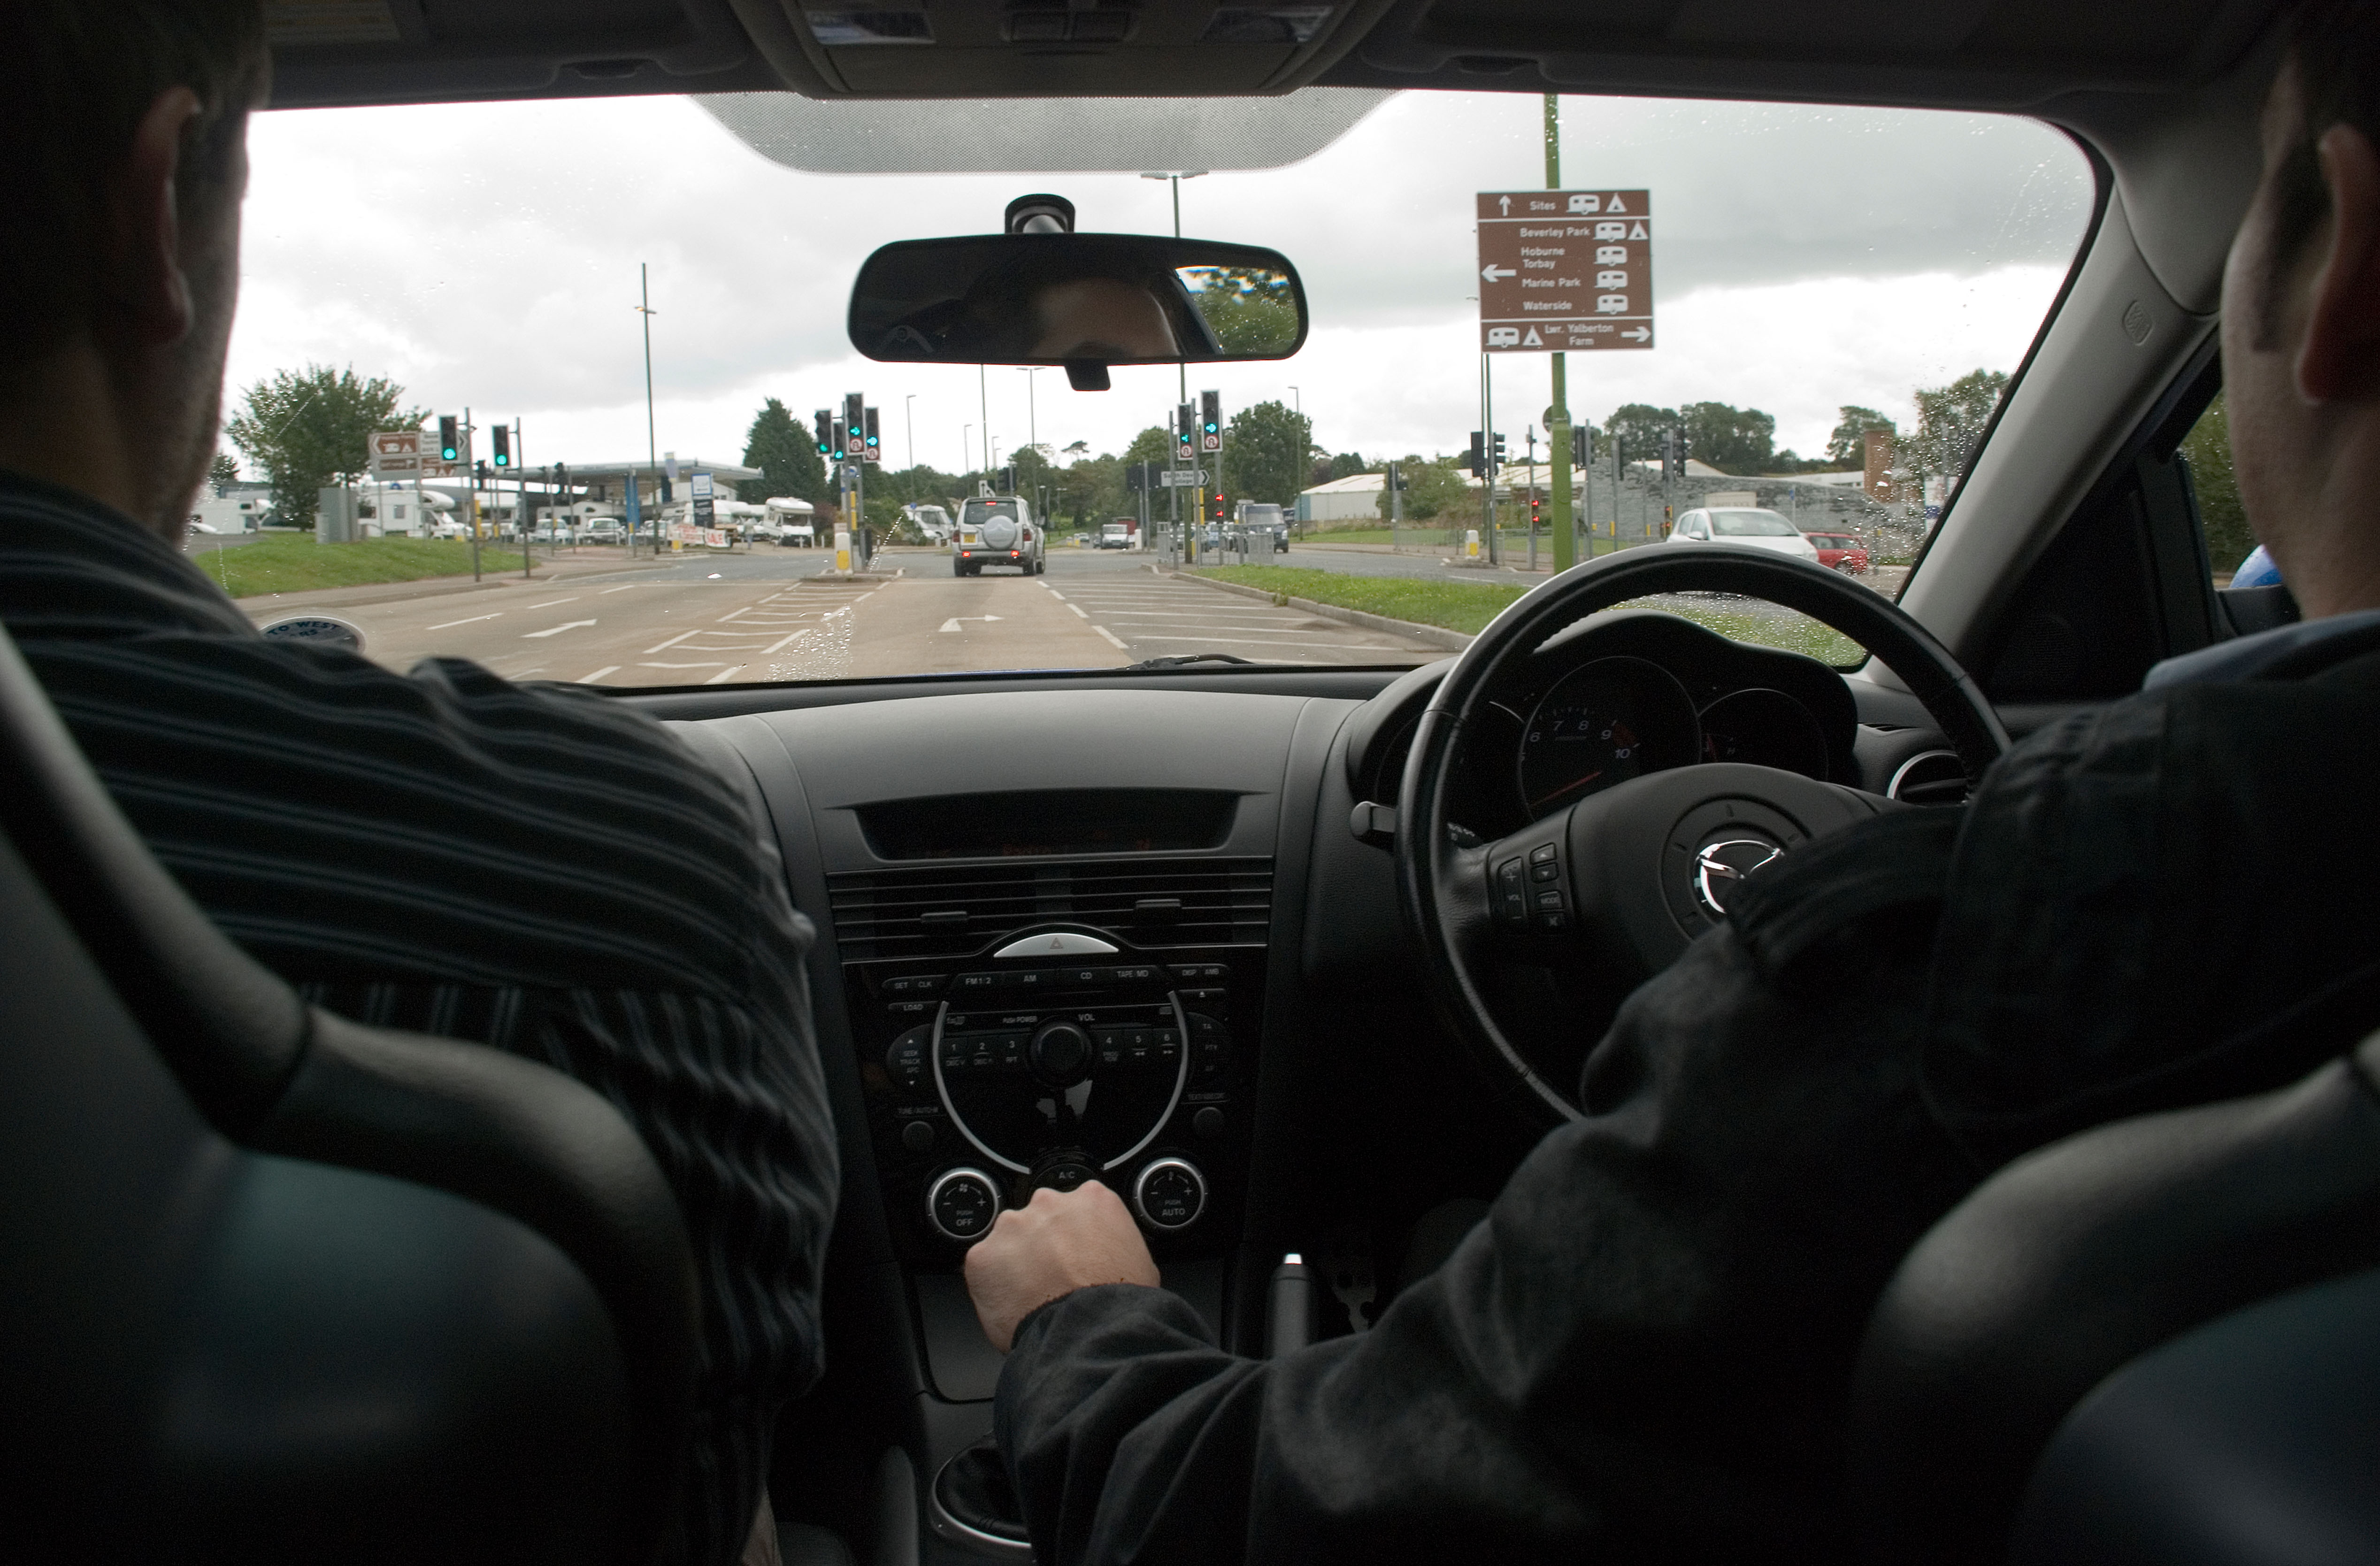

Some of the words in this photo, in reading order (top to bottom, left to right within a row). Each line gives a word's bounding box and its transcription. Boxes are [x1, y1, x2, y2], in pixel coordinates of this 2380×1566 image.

[1530, 201, 1556, 210] Sites
[1520, 227, 1564, 239] Beverley
[1567, 226, 1590, 236] Park
[1521, 247, 1565, 256] Hoburne
[1523, 259, 1556, 270] Torbay
[1522, 278, 1555, 288] Marine
[1559, 278, 1581, 287] Park
[1523, 301, 1572, 311] Waterside
[1567, 324, 1614, 334] Yalberton
[1569, 336, 1594, 346] Farm
[296, 621, 341, 631] WEST
[1553, 720, 1564, 731] 7
[1578, 720, 1589, 731] 8
[1529, 732, 1541, 742] 6
[1600, 729, 1612, 740] 9
[1615, 748, 1631, 759] 10
[1161, 1208, 1186, 1217] AUTO
